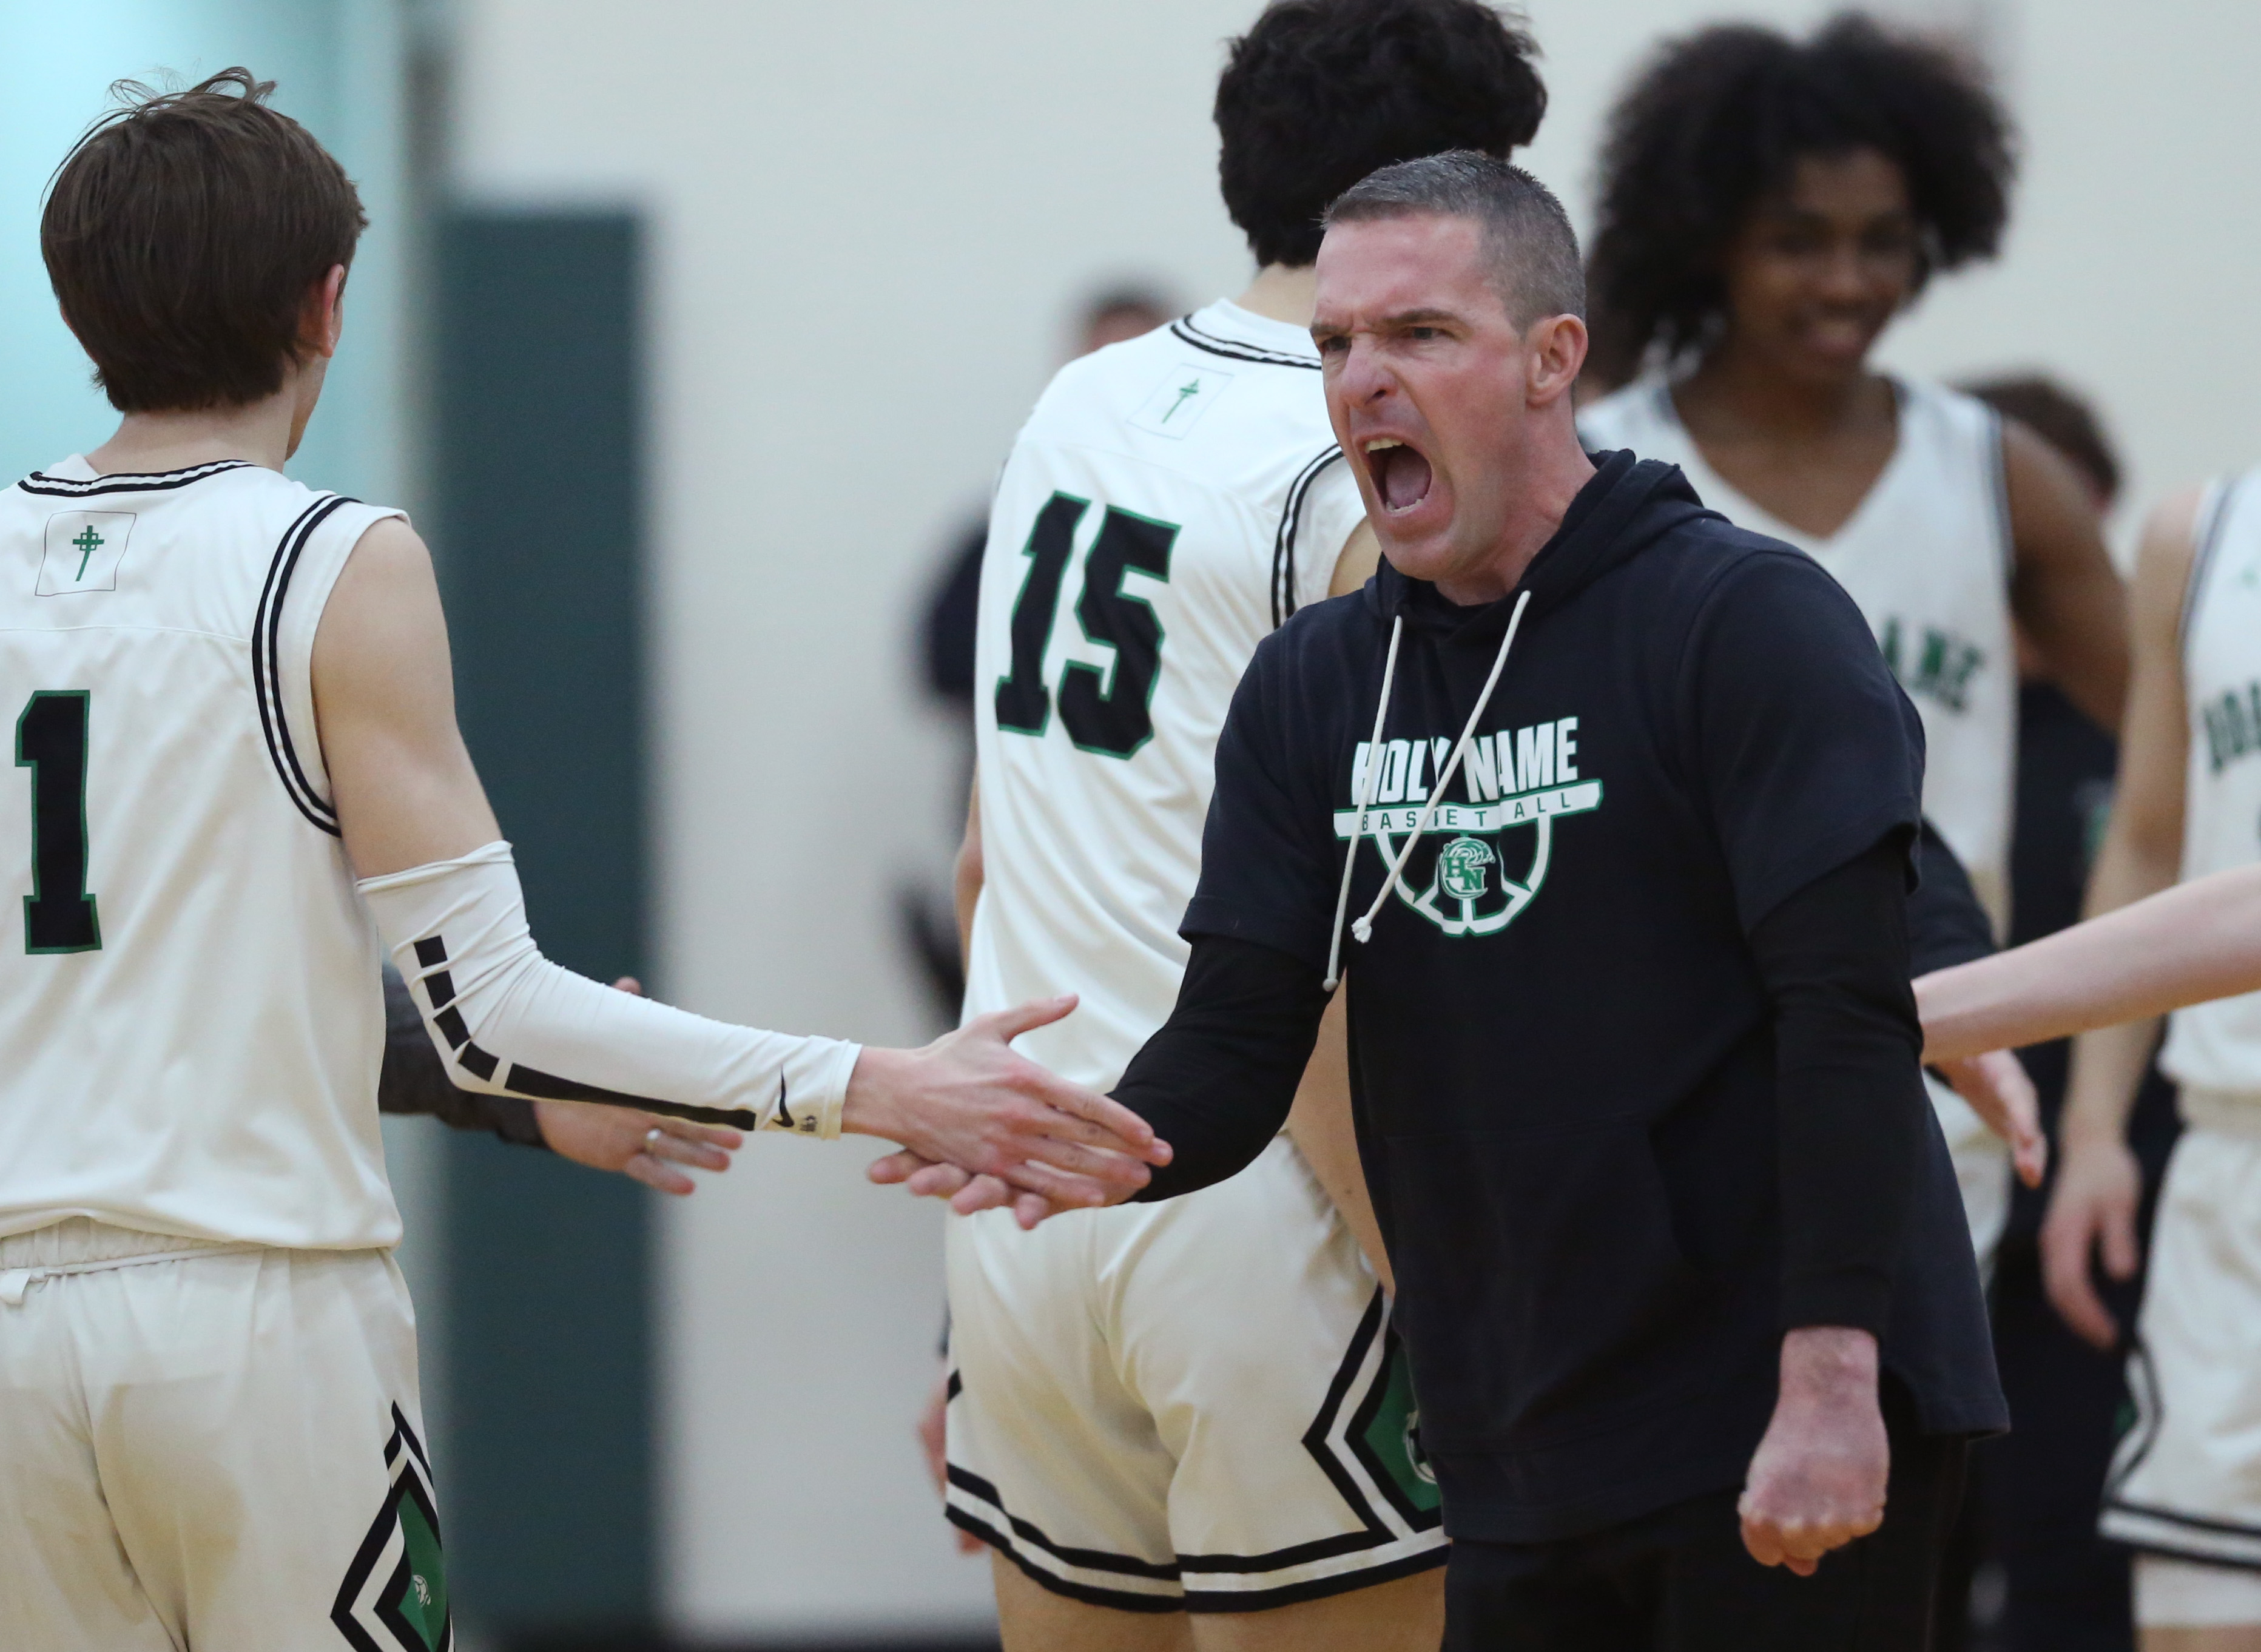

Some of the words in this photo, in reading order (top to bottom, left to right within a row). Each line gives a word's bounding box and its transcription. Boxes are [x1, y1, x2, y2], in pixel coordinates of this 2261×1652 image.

[995, 490, 1182, 760] 15
[15, 690, 102, 955] 1
[1350, 735, 1452, 806] HOLY
[1462, 716, 1579, 804] NAME
[1444, 856, 1484, 891] HN
